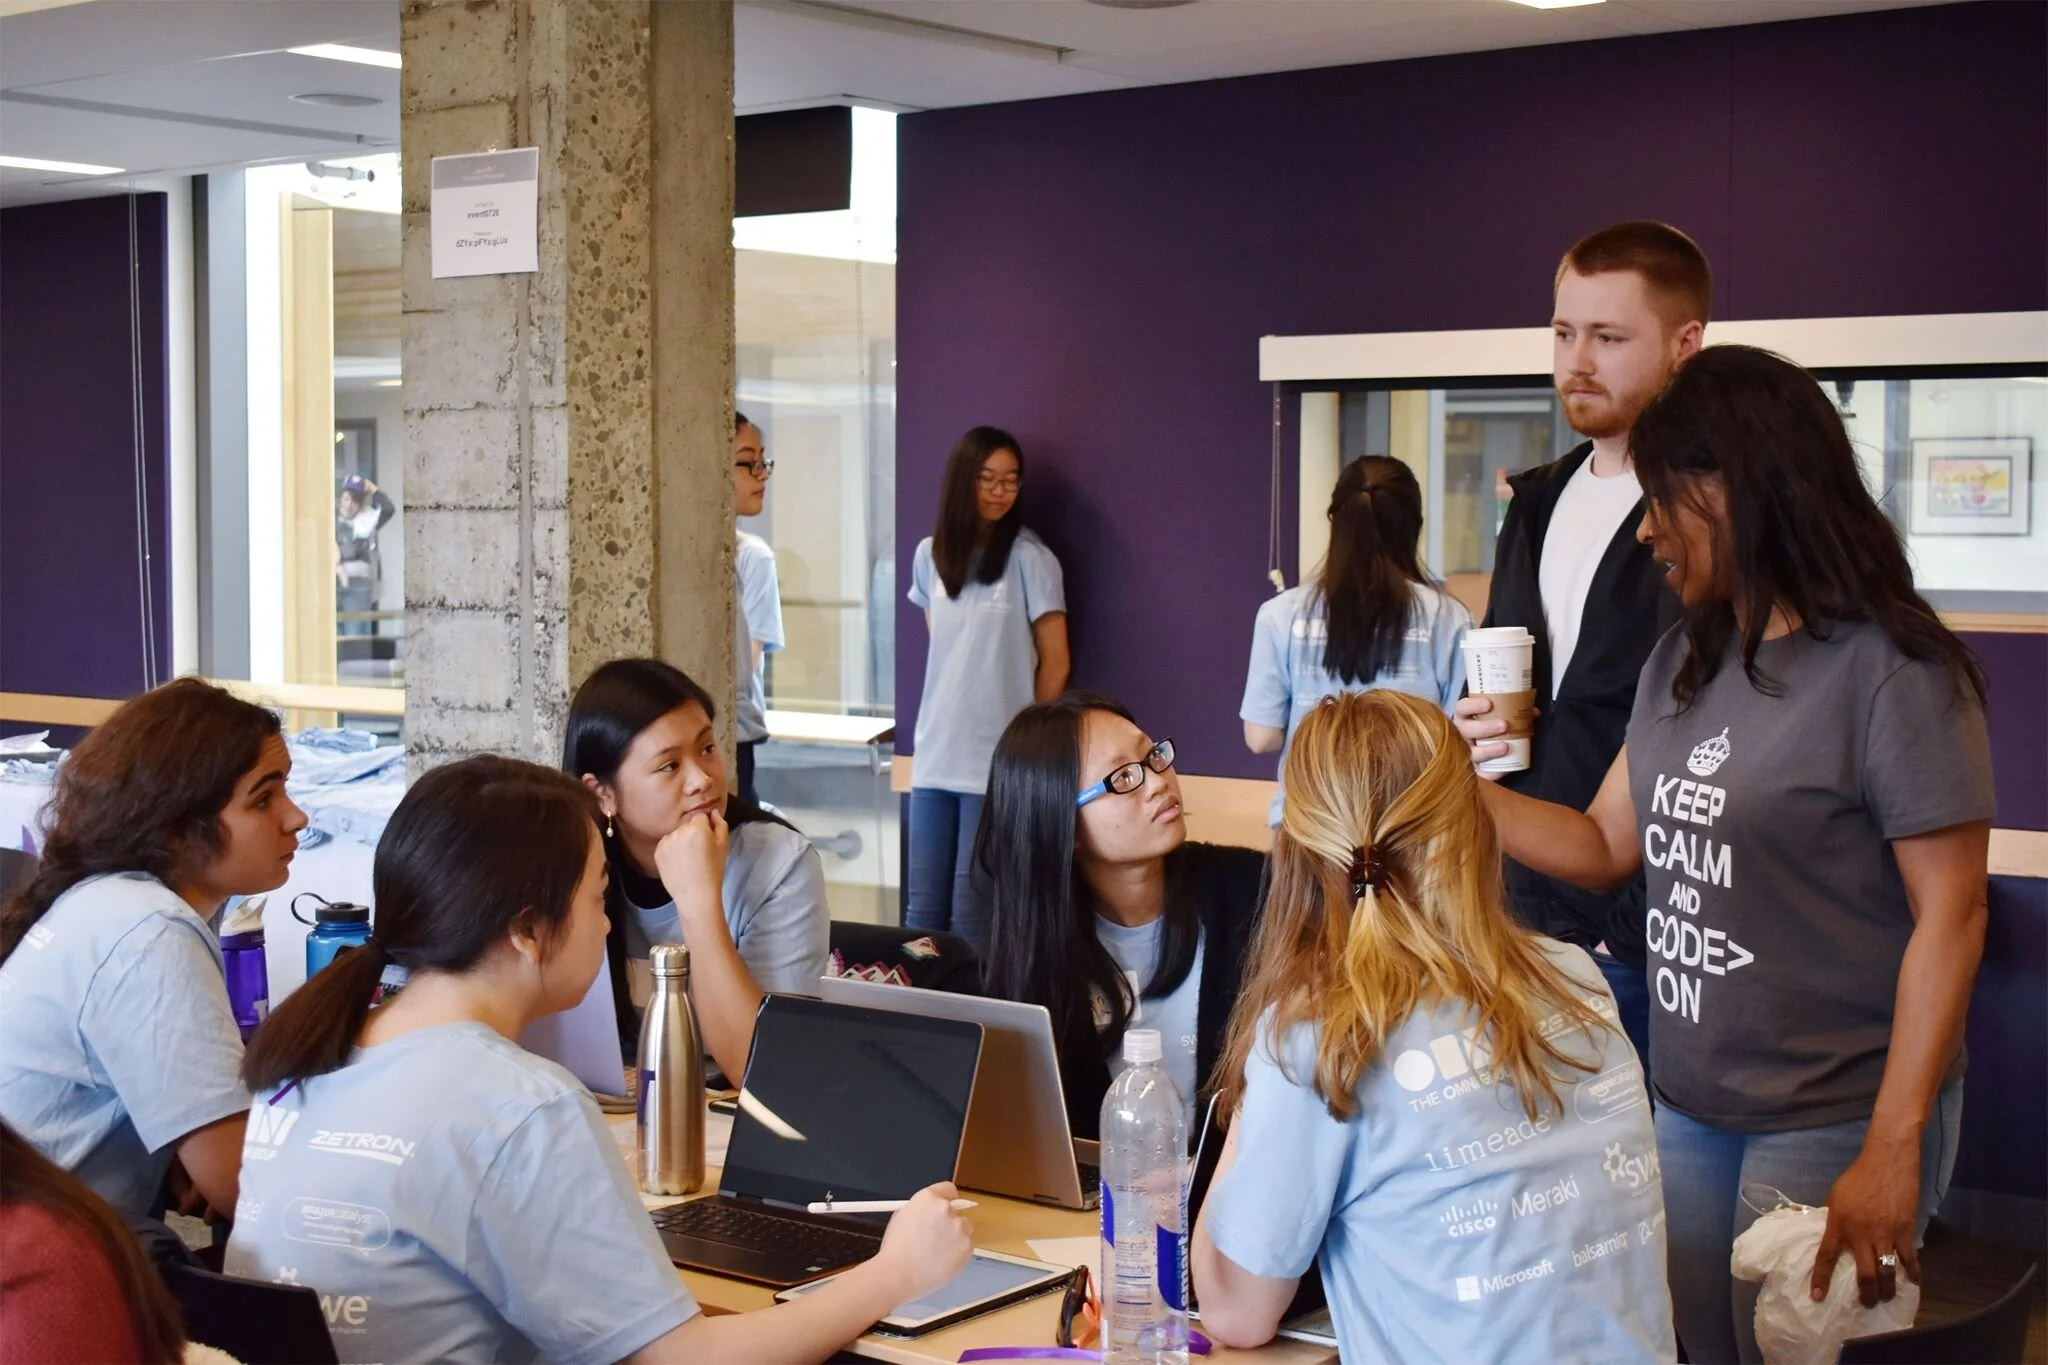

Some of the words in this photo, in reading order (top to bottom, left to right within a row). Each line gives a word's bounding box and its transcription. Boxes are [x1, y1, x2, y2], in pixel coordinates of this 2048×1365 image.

[1651, 773, 1726, 827] KEEP
[1645, 823, 1732, 888] CALM
[1668, 881, 1700, 915] AND
[1656, 967, 1702, 1023] ON
[1408, 1091, 1441, 1113] THE
[309, 1129, 416, 1158] ZETRON
[1424, 1112, 1551, 1173] limeade
[1511, 1175, 1580, 1220] Meraki
[1482, 1258, 1555, 1294] Microsoft
